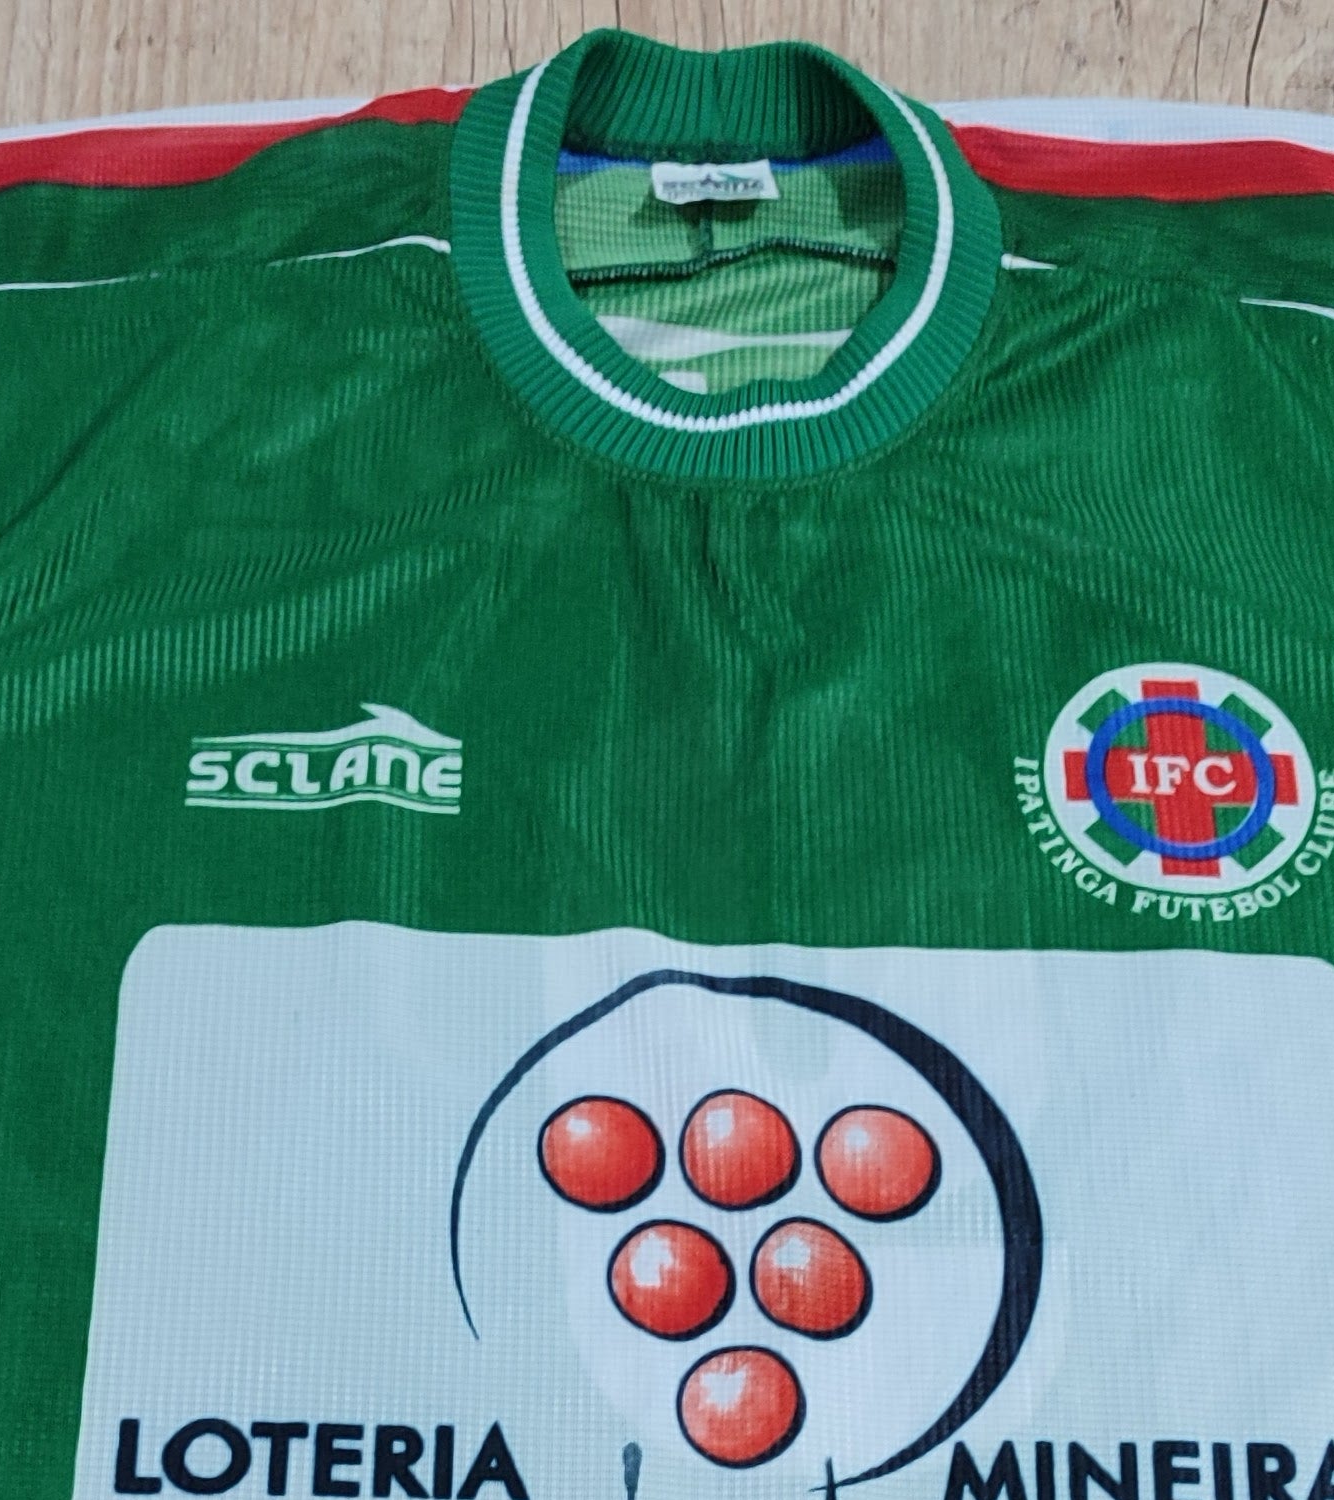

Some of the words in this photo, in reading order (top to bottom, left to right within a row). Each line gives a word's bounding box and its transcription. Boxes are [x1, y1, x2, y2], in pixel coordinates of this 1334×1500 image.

[186, 744, 463, 798] SCLANE
[1127, 752, 1237, 795] IFC
[1014, 756, 1118, 905] IPATINGA
[1132, 873, 1300, 921] FUTEBOL
